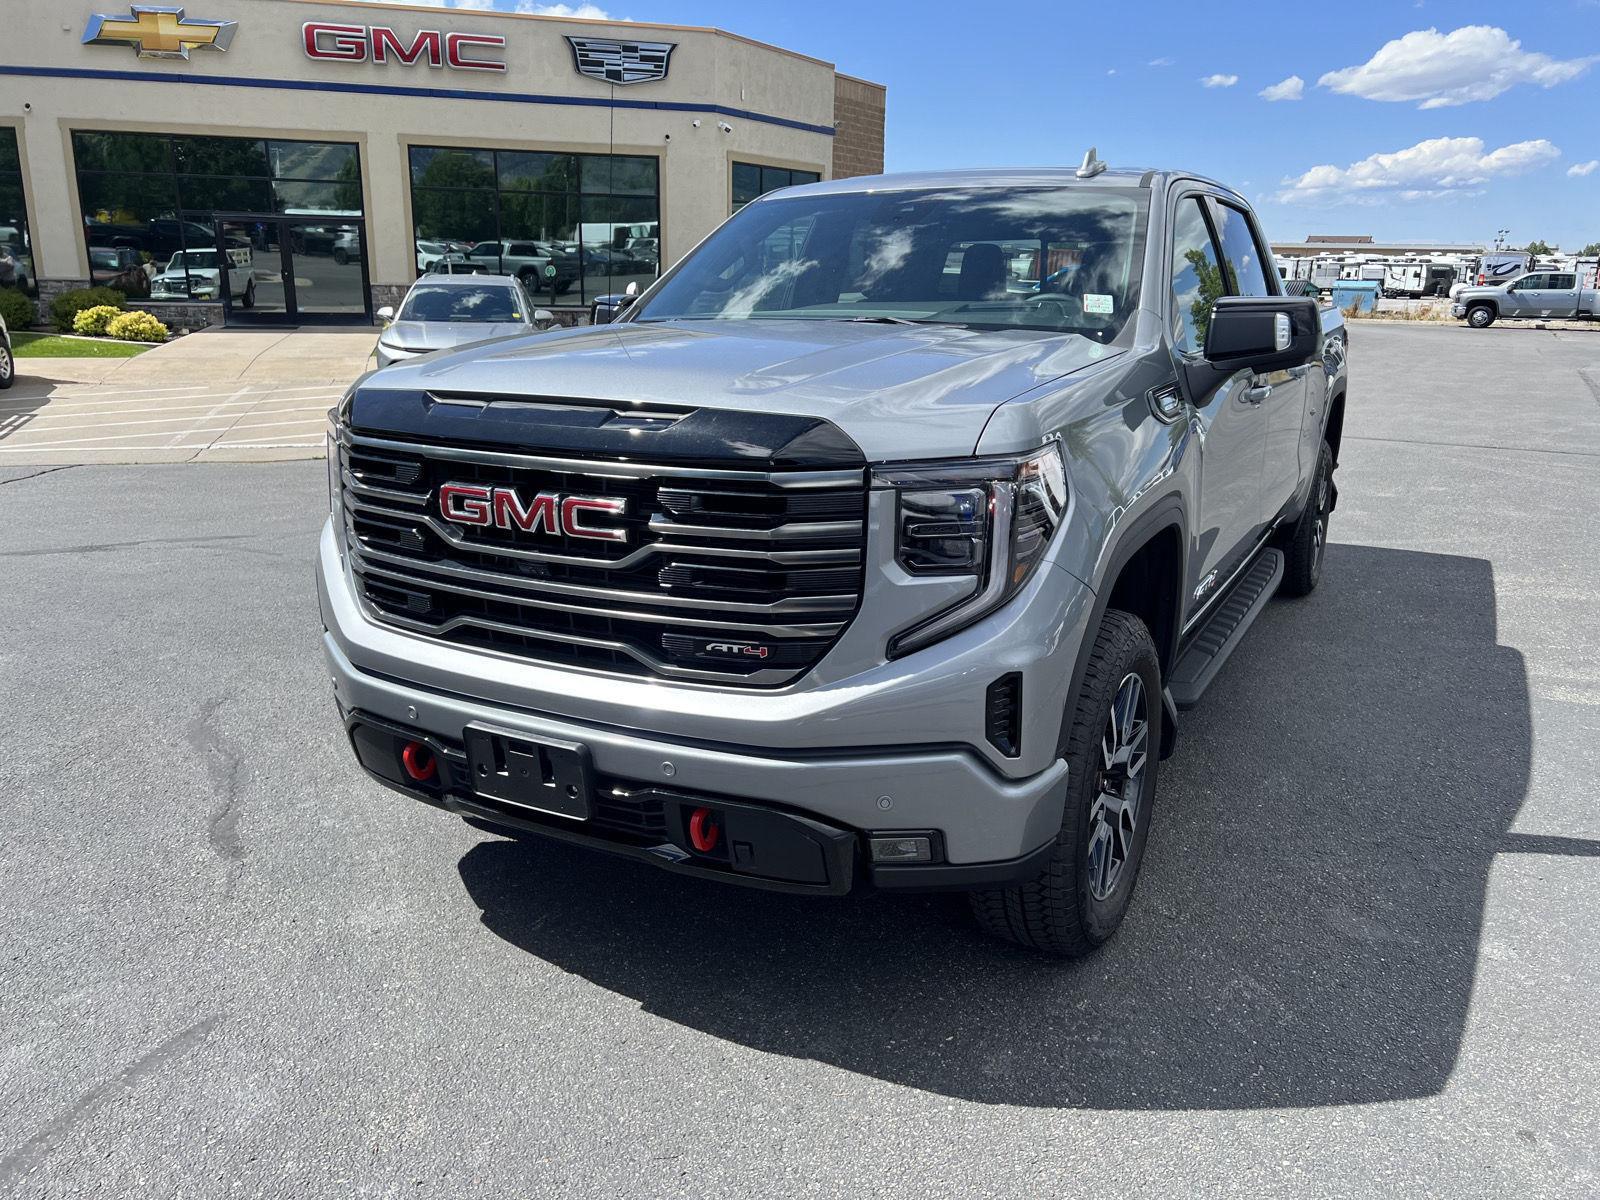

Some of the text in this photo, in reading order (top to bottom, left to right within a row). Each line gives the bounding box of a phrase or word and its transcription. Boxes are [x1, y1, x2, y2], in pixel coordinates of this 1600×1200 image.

[302, 21, 506, 73] GMC
[439, 481, 627, 542] GMC
[705, 643, 768, 659] AT4
